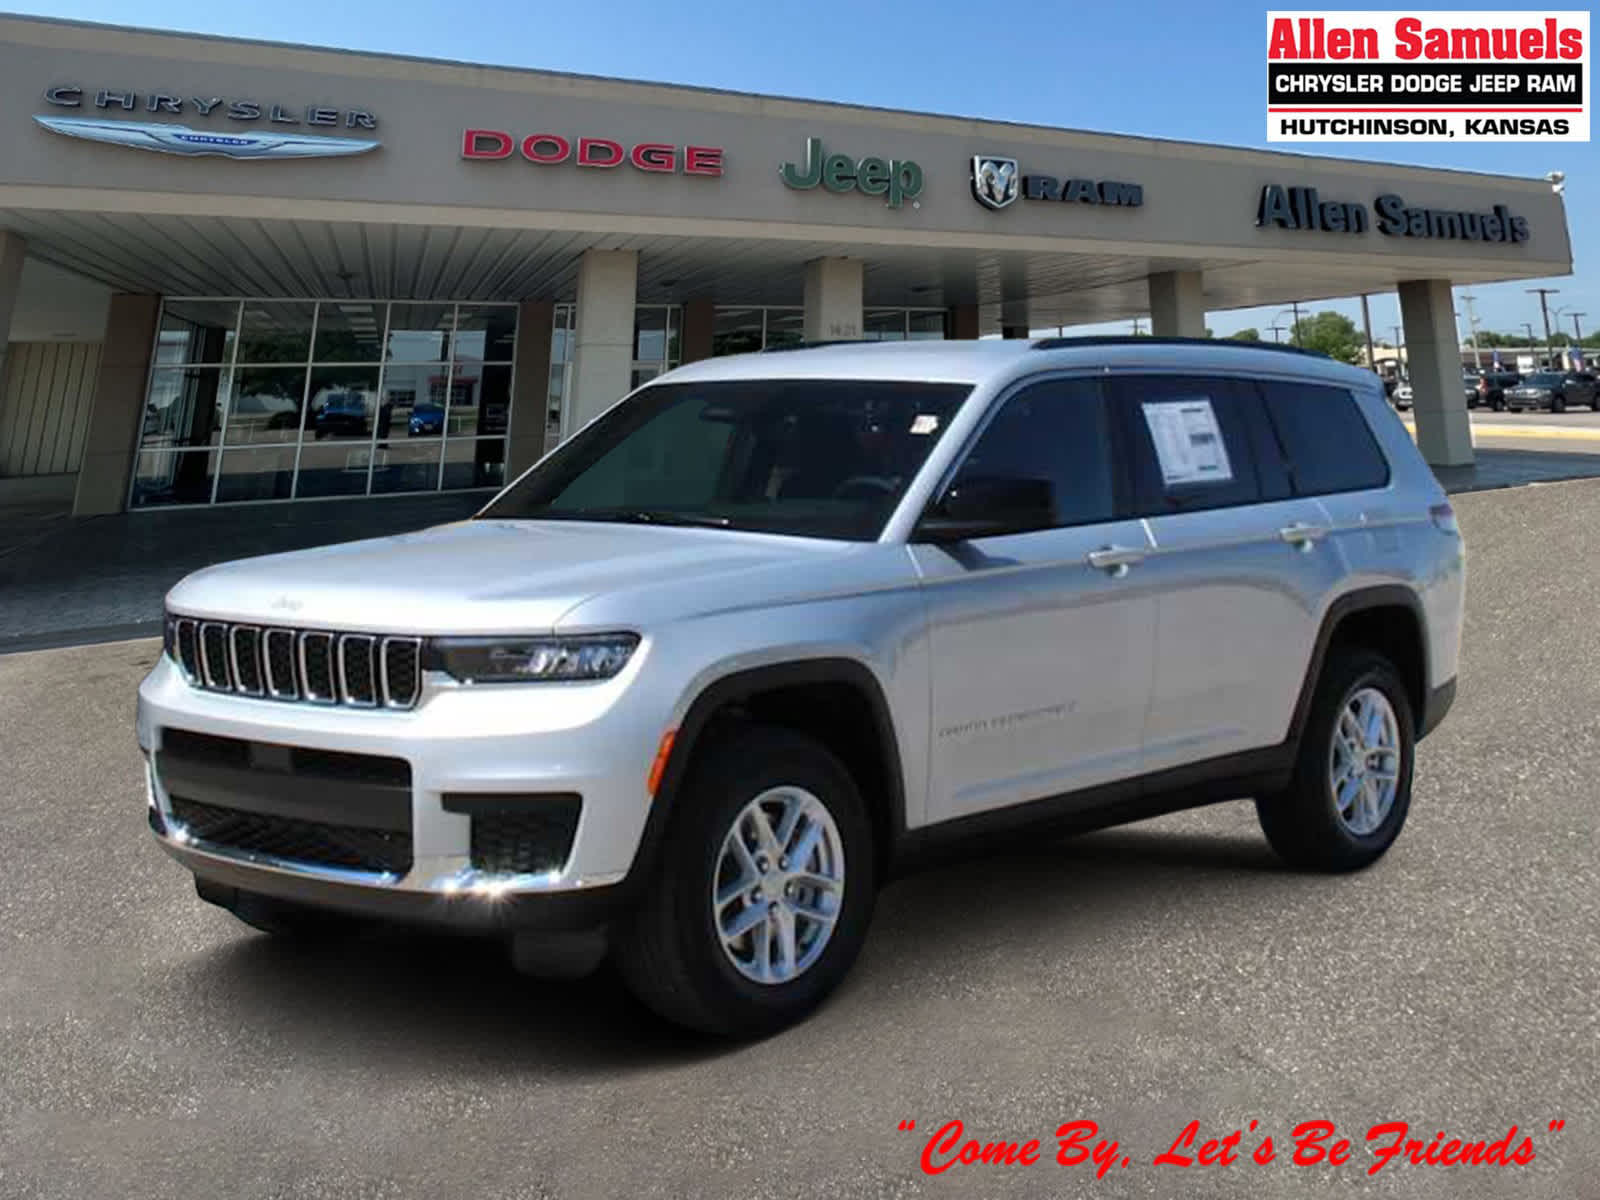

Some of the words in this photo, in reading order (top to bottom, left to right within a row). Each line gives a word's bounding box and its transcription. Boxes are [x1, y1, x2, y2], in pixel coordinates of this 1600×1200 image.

[43, 86, 378, 129] CHRYSLER
[461, 128, 724, 176] DODGE
[780, 136, 923, 209] Jeep
[1022, 175, 1145, 208] RAM
[1256, 184, 1369, 234] Allen
[1375, 193, 1531, 243] Samuels
